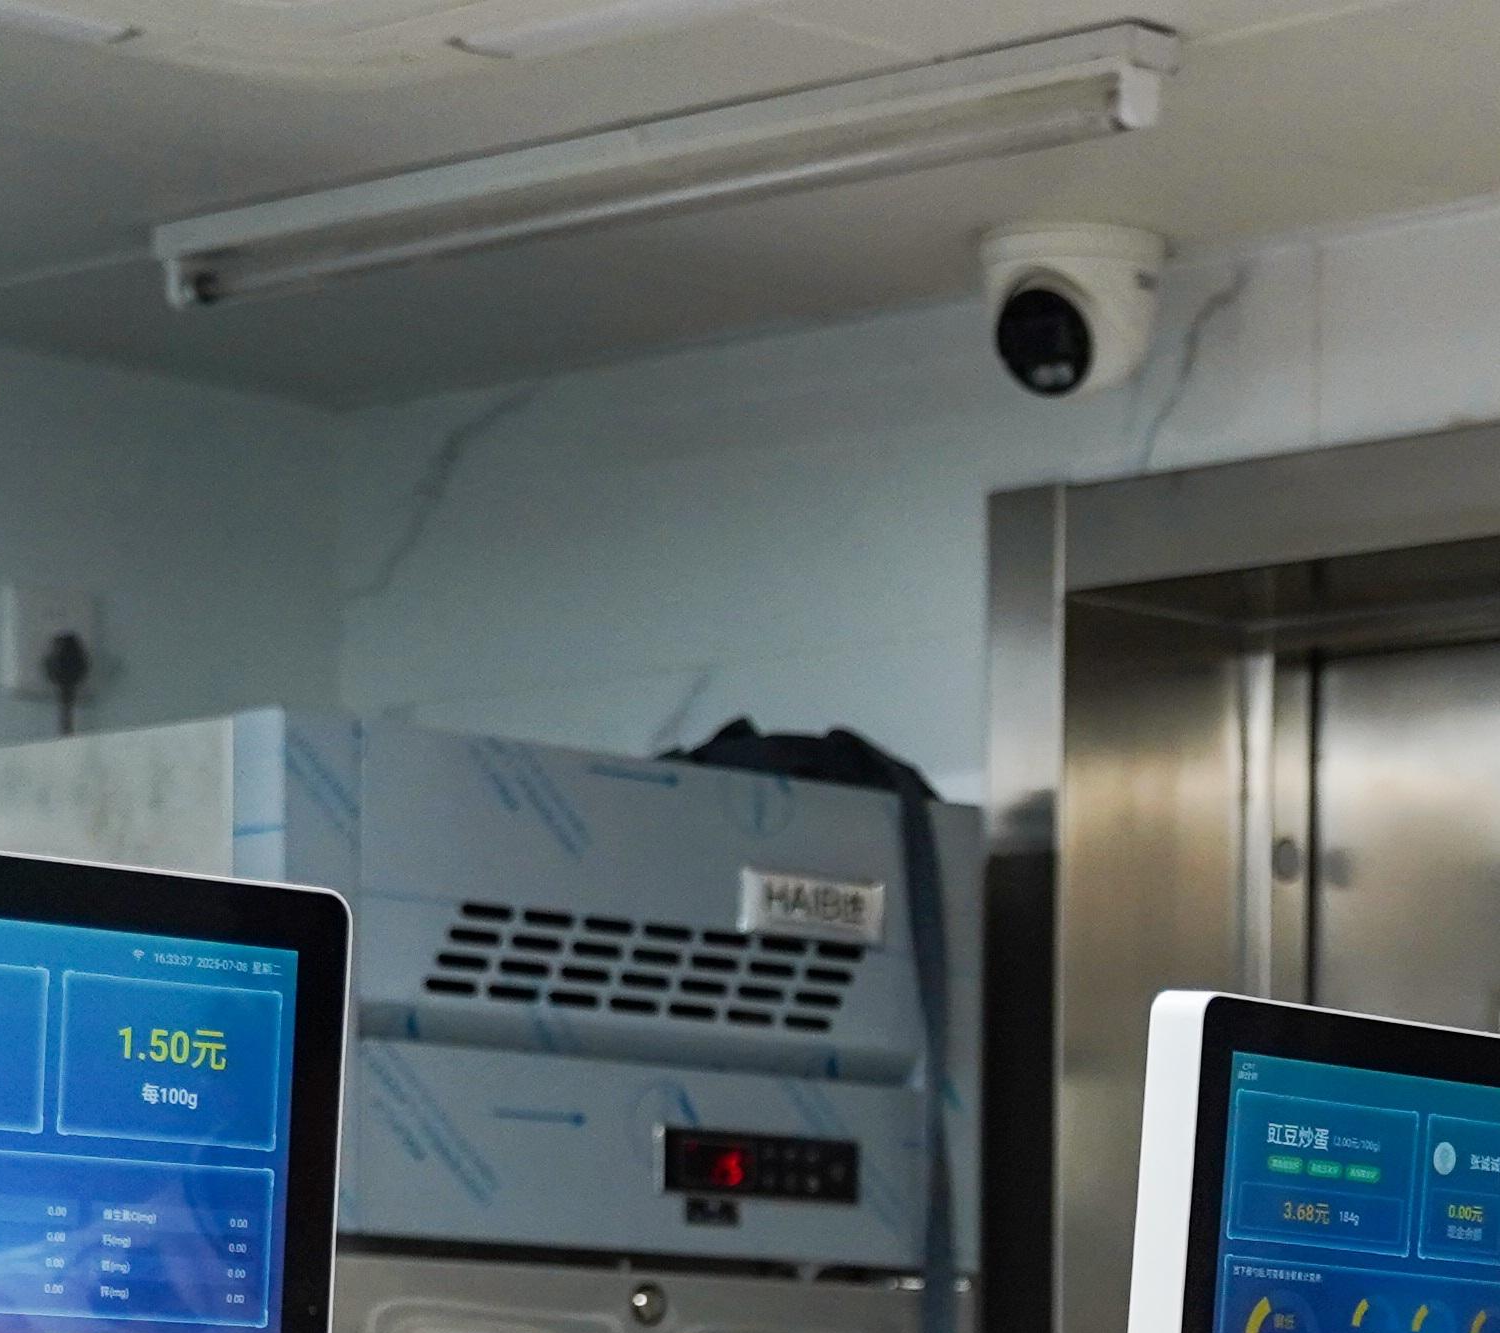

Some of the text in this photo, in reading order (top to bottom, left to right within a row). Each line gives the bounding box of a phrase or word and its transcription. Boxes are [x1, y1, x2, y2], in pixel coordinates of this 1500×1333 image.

[118, 1026, 227, 1071] 1.50元
[141, 1082, 198, 1110] 每100g
[1267, 1123, 1330, 1151] 豇豆炒蛋
[1283, 1201, 1359, 1227] 3.68元 184g
[1448, 1204, 1483, 1223] 0.00元
